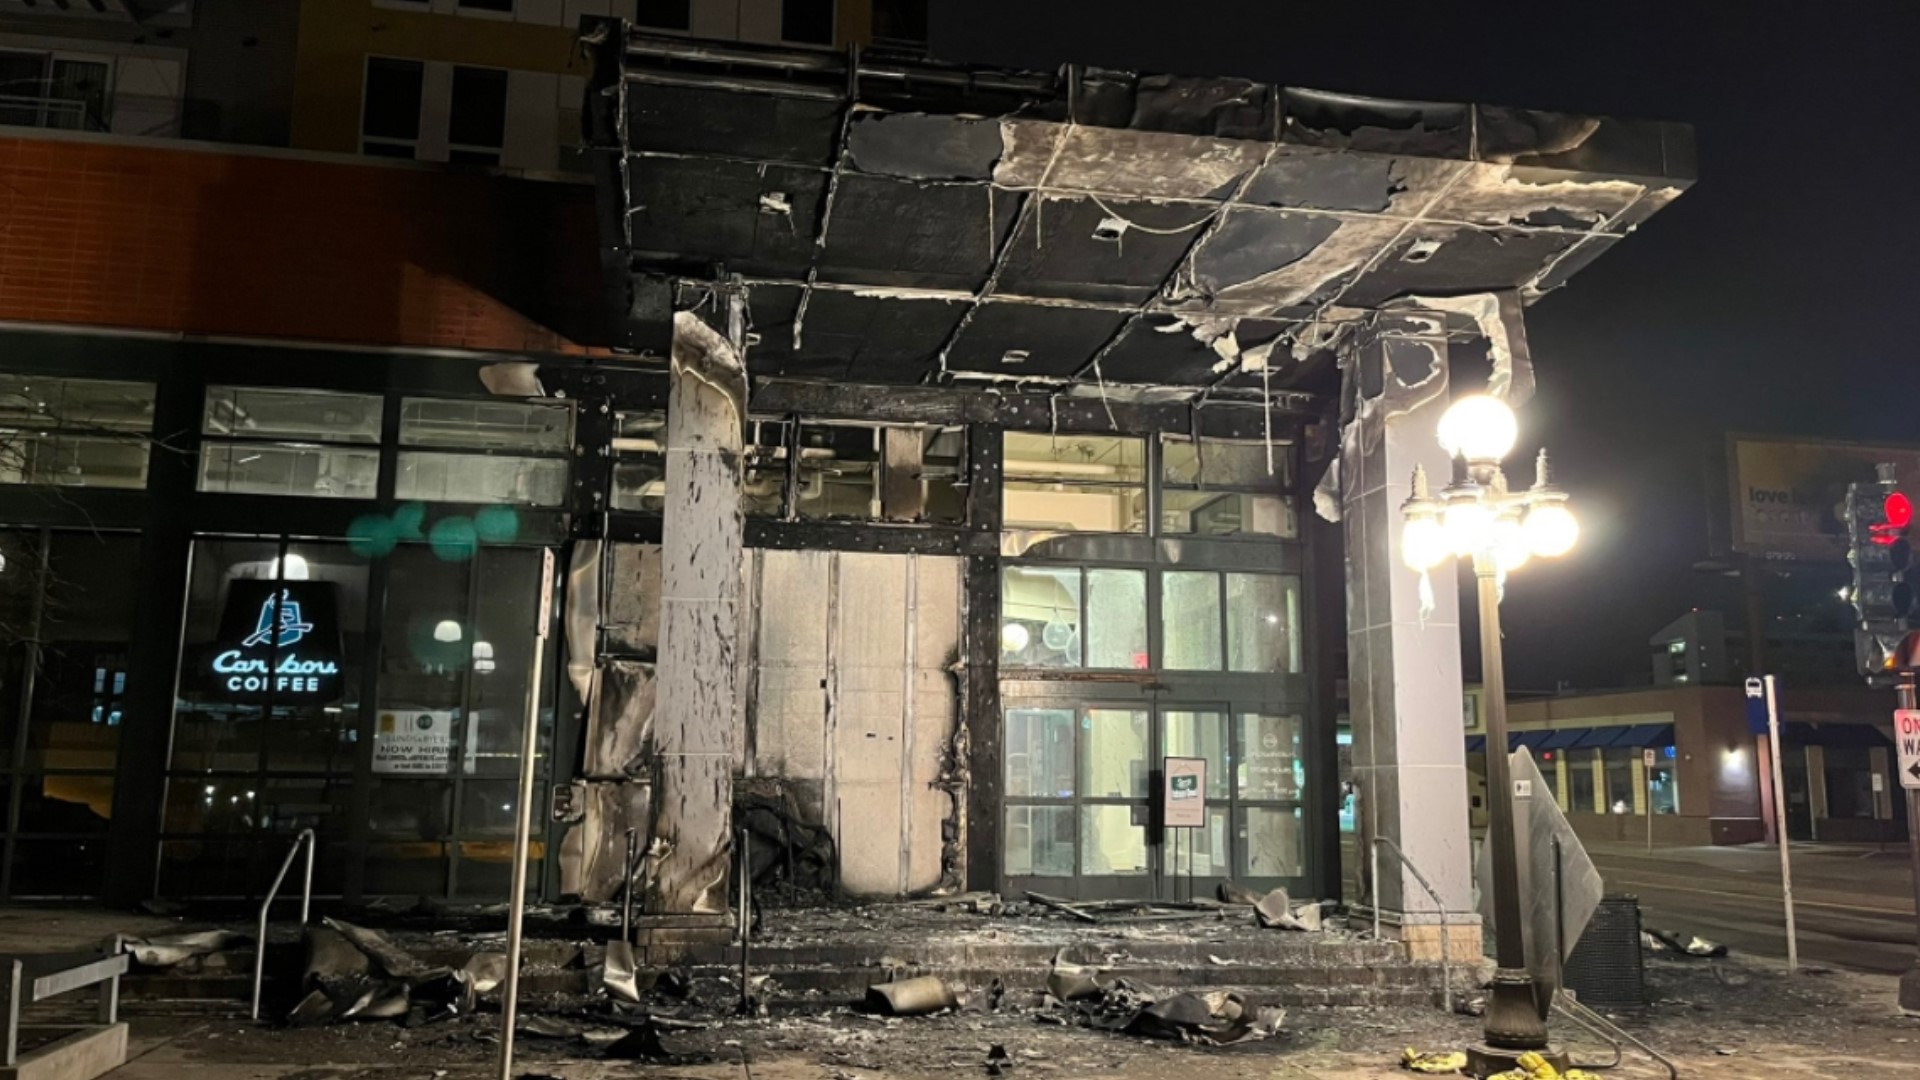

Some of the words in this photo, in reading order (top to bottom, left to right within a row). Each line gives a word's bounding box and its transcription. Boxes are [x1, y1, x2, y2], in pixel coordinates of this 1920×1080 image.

[1749, 486, 1788, 504] love
[212, 650, 338, 673] Carbou
[1902, 717, 1920, 734] ON
[380, 745, 412, 754] NOW
[418, 745, 451, 754] HIRIN
[1903, 738, 1920, 756] WA
